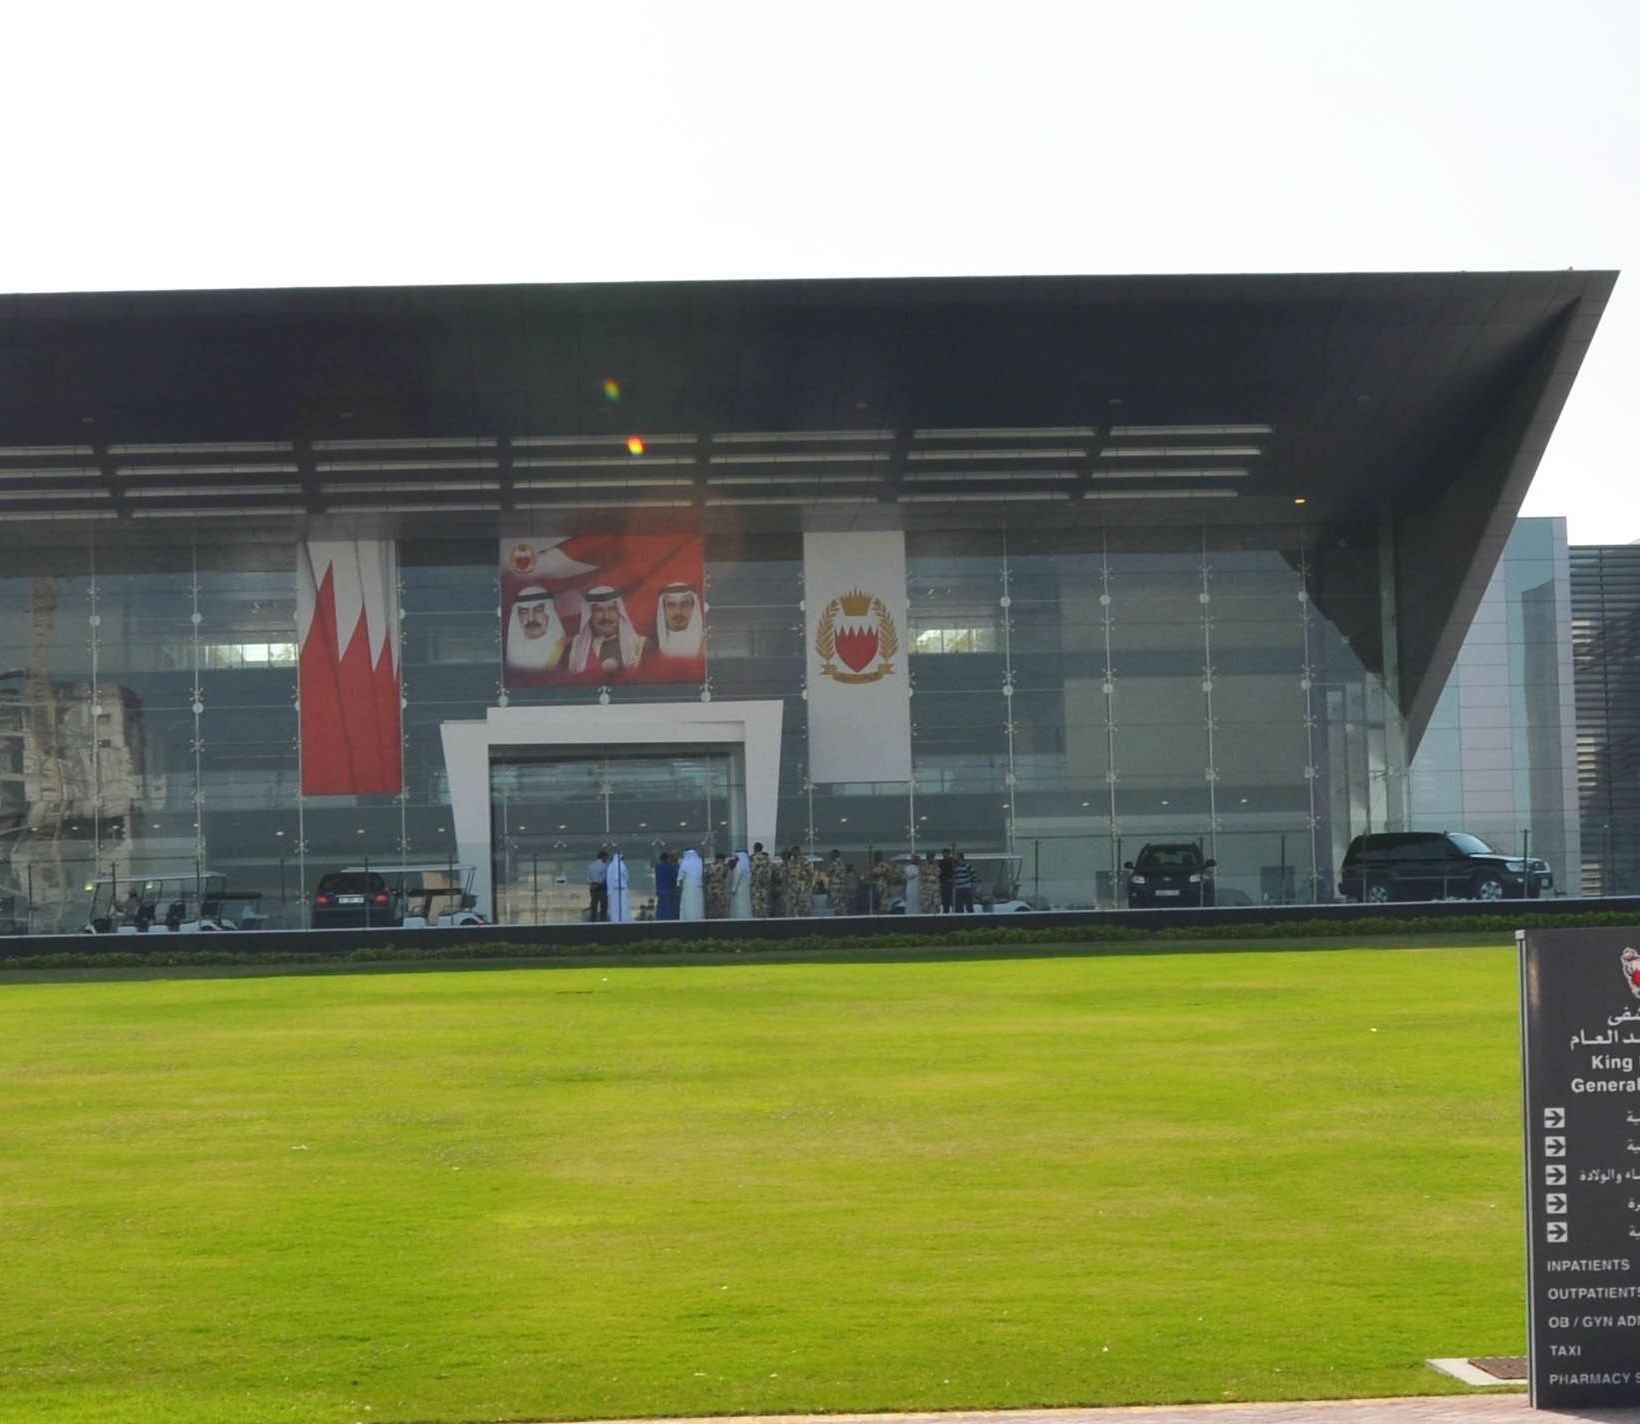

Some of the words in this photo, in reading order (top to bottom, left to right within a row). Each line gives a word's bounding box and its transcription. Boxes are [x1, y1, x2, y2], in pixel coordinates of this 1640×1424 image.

[1570, 1028, 1618, 1050] العام
[1591, 1054, 1633, 1072] King
[1571, 1077, 1640, 1093] General
[1547, 1259, 1630, 1272] INPATIENTS
[1548, 1316, 1569, 1328] OB
[1573, 1316, 1579, 1327] /
[1582, 1315, 1613, 1327] GYN
[1549, 1345, 1581, 1356] TAXI
[1549, 1372, 1630, 1385] PHARMACY
